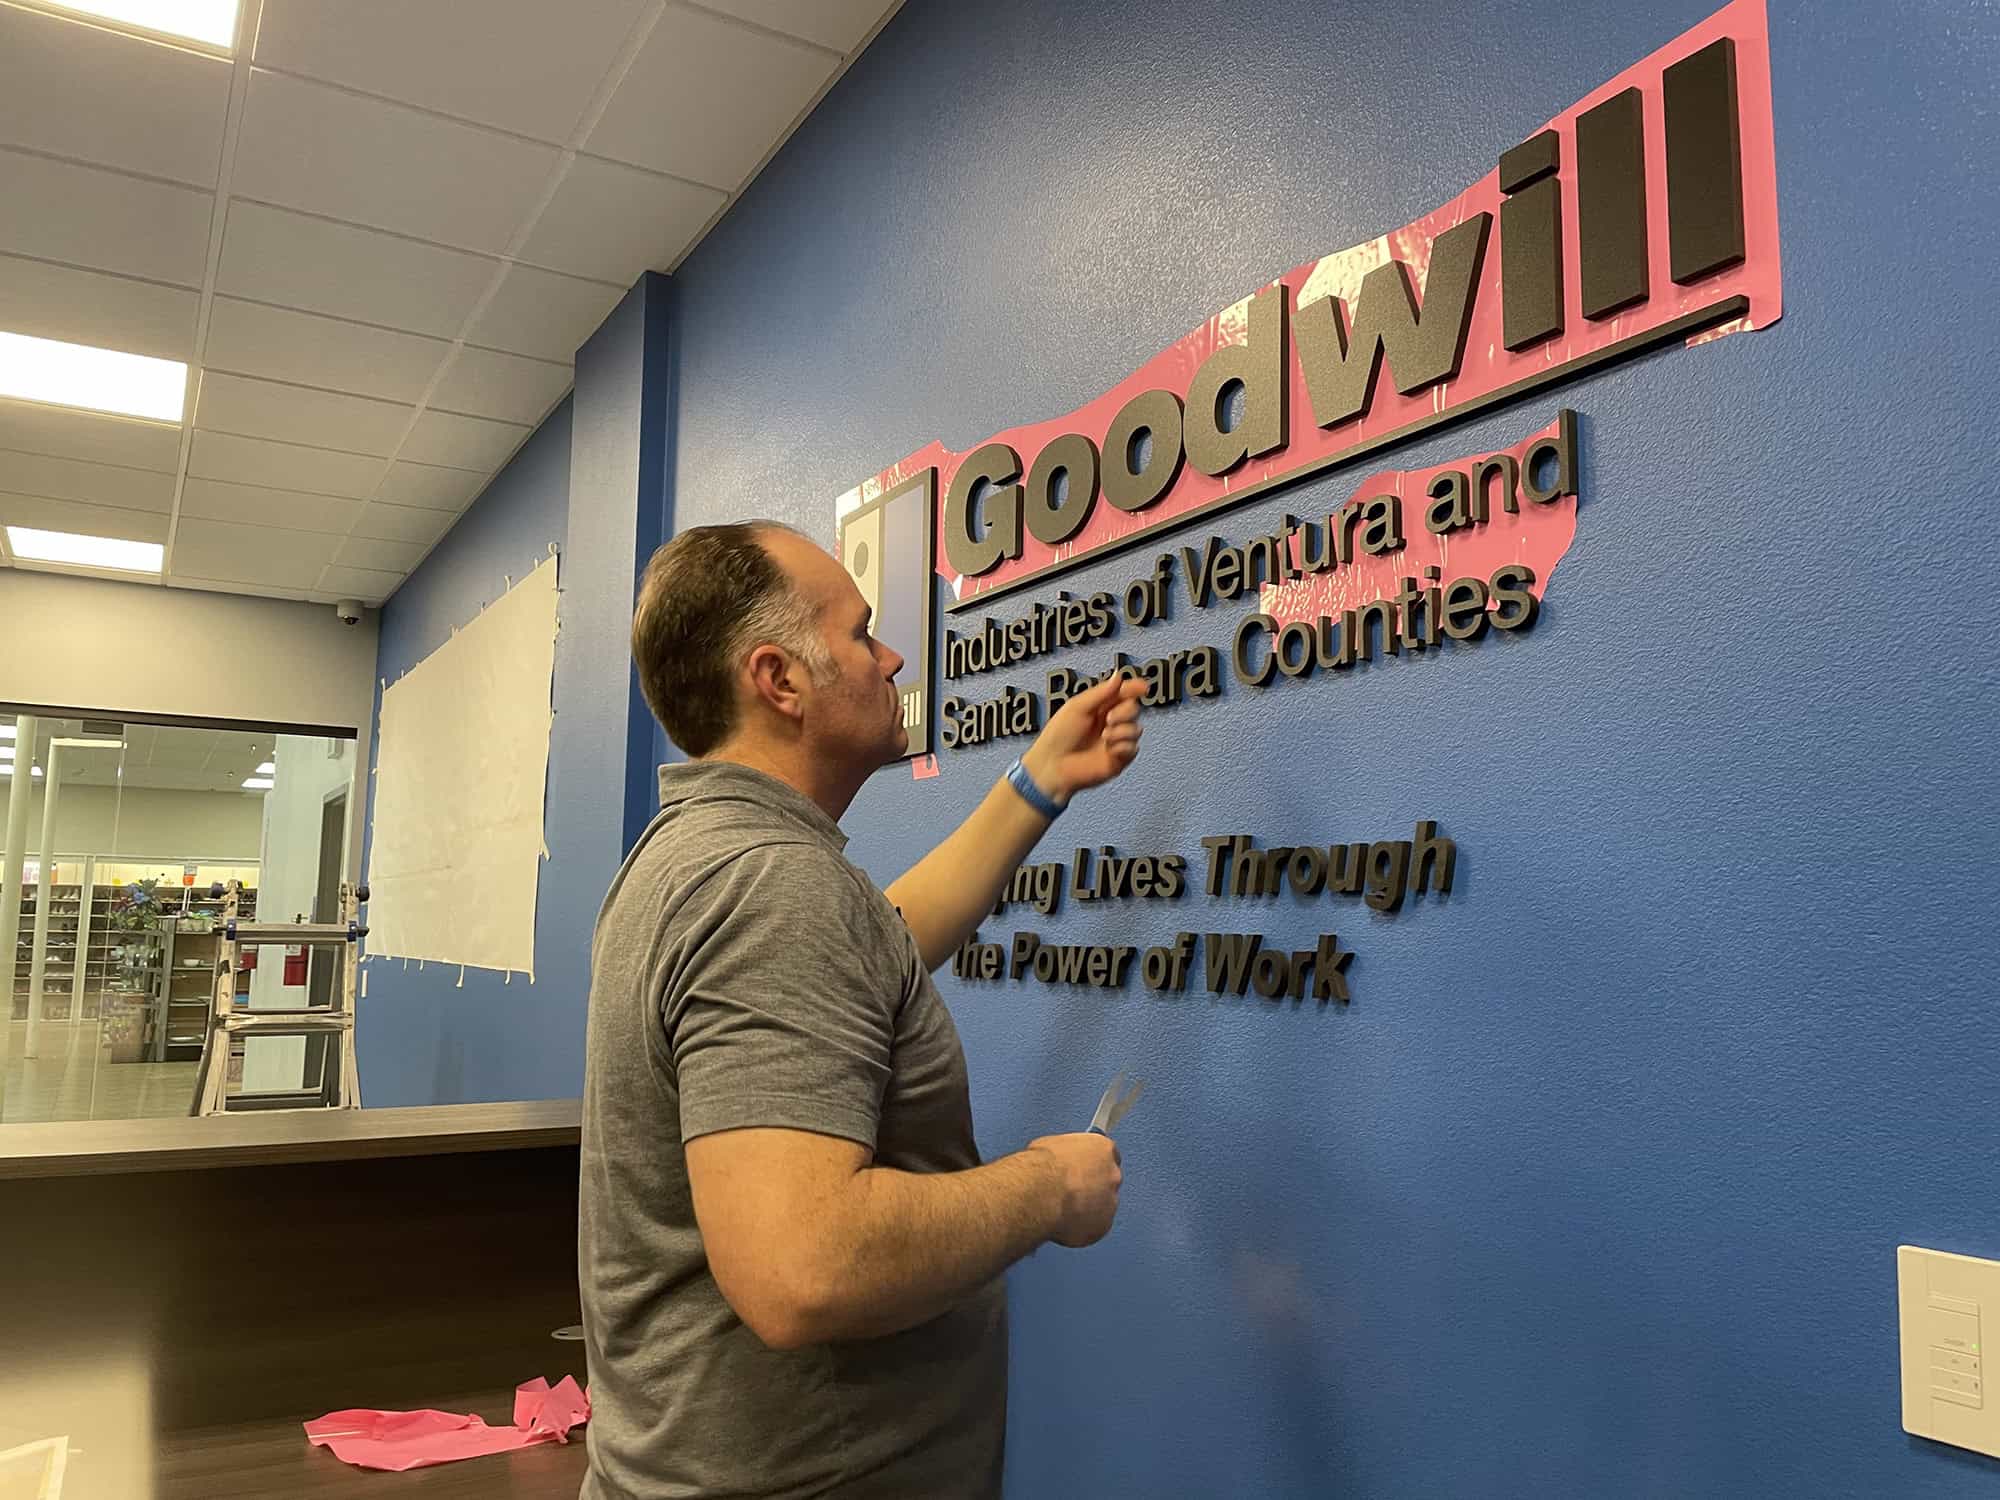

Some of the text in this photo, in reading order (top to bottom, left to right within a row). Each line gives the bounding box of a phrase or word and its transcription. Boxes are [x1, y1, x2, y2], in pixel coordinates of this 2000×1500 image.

[944, 37, 1745, 577] Goodwill
[945, 408, 1578, 680] Industries of Ventura and
[940, 685, 1038, 749] Santa
[1231, 565, 1539, 686] Counties
[1070, 846, 1187, 899] Lives
[1201, 820, 1457, 912] Through
[1009, 931, 1136, 987] Power
[1142, 932, 1198, 990] of
[1204, 933, 1356, 1004] Work
